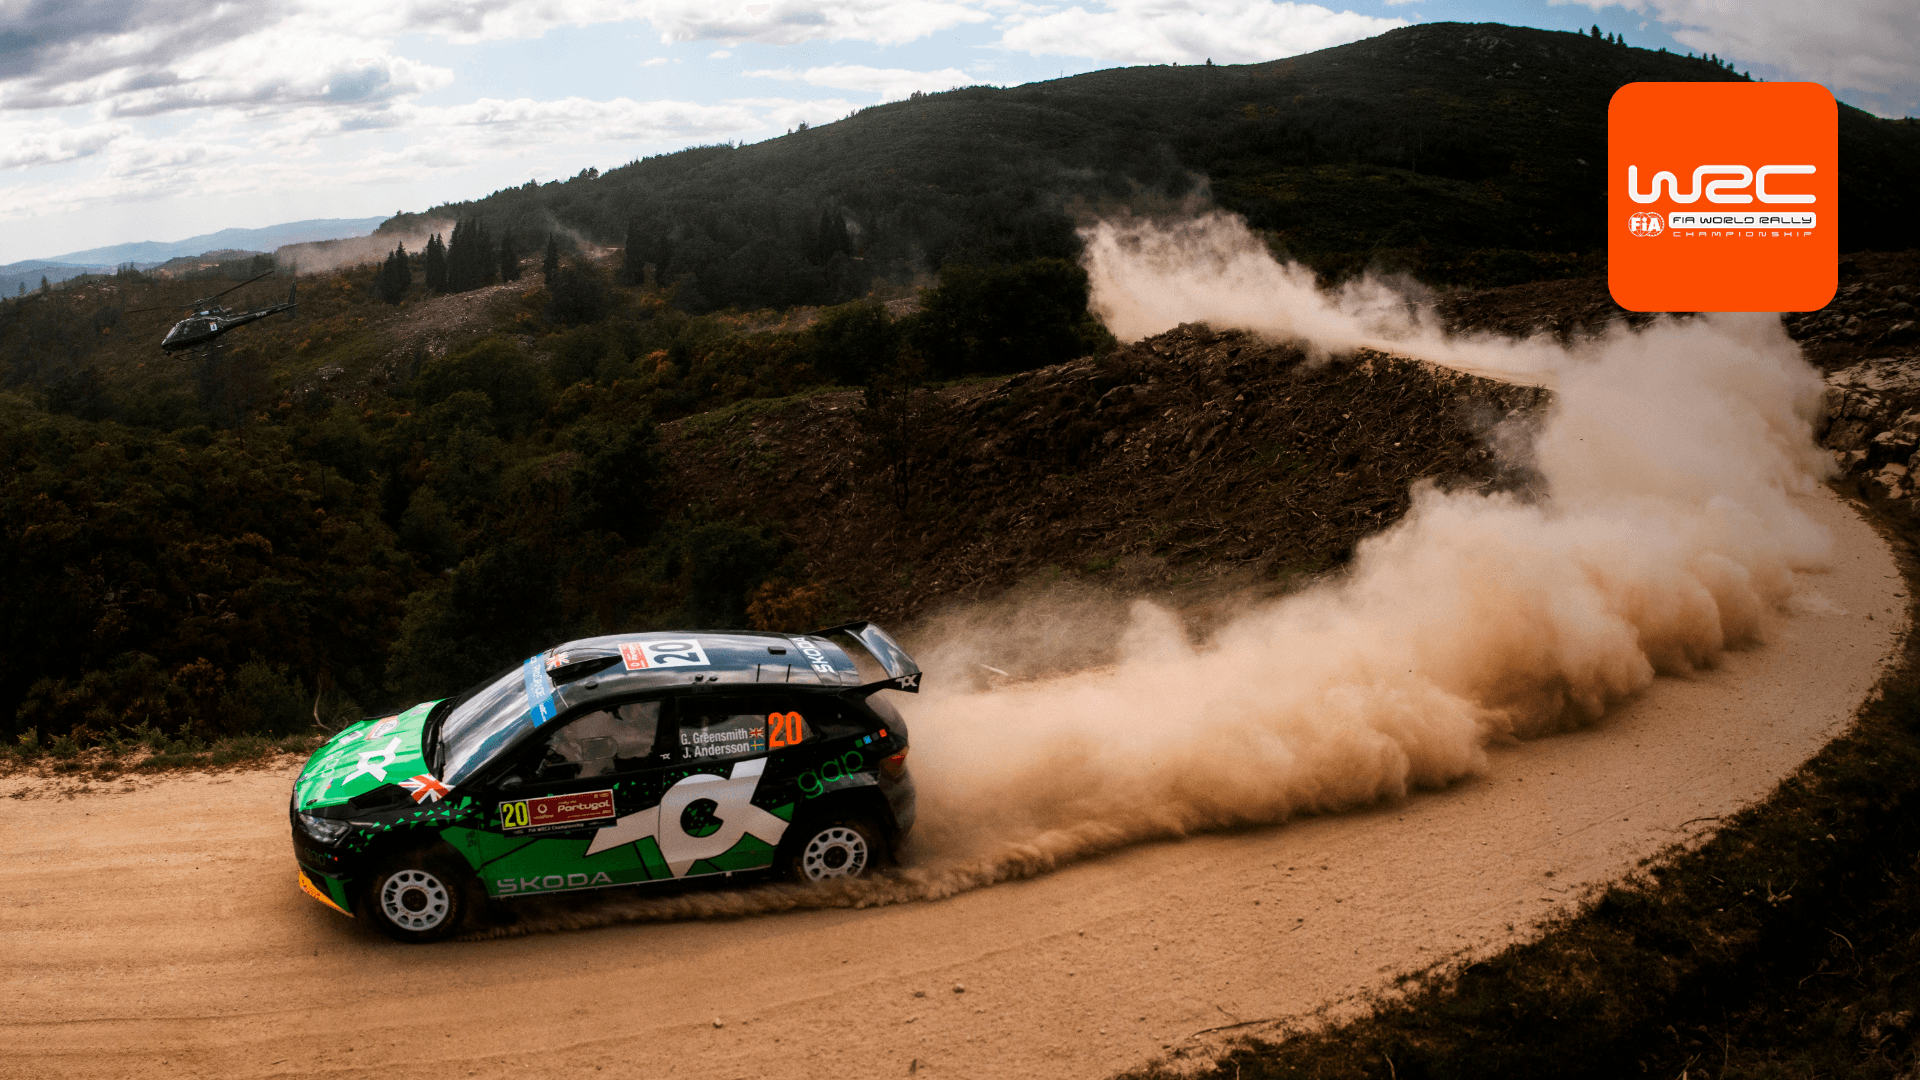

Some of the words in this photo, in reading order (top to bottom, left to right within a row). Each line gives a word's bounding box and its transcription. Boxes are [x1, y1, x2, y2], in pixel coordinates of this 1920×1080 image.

[649, 642, 701, 664] 20
[681, 733, 691, 745] G.
[693, 728, 748, 744] Greensmith
[768, 711, 803, 747] 20
[682, 747, 692, 758] J.
[694, 742, 750, 757] Andersson
[798, 751, 863, 799] gap
[503, 802, 529, 827] 20
[557, 800, 611, 813] Portugal
